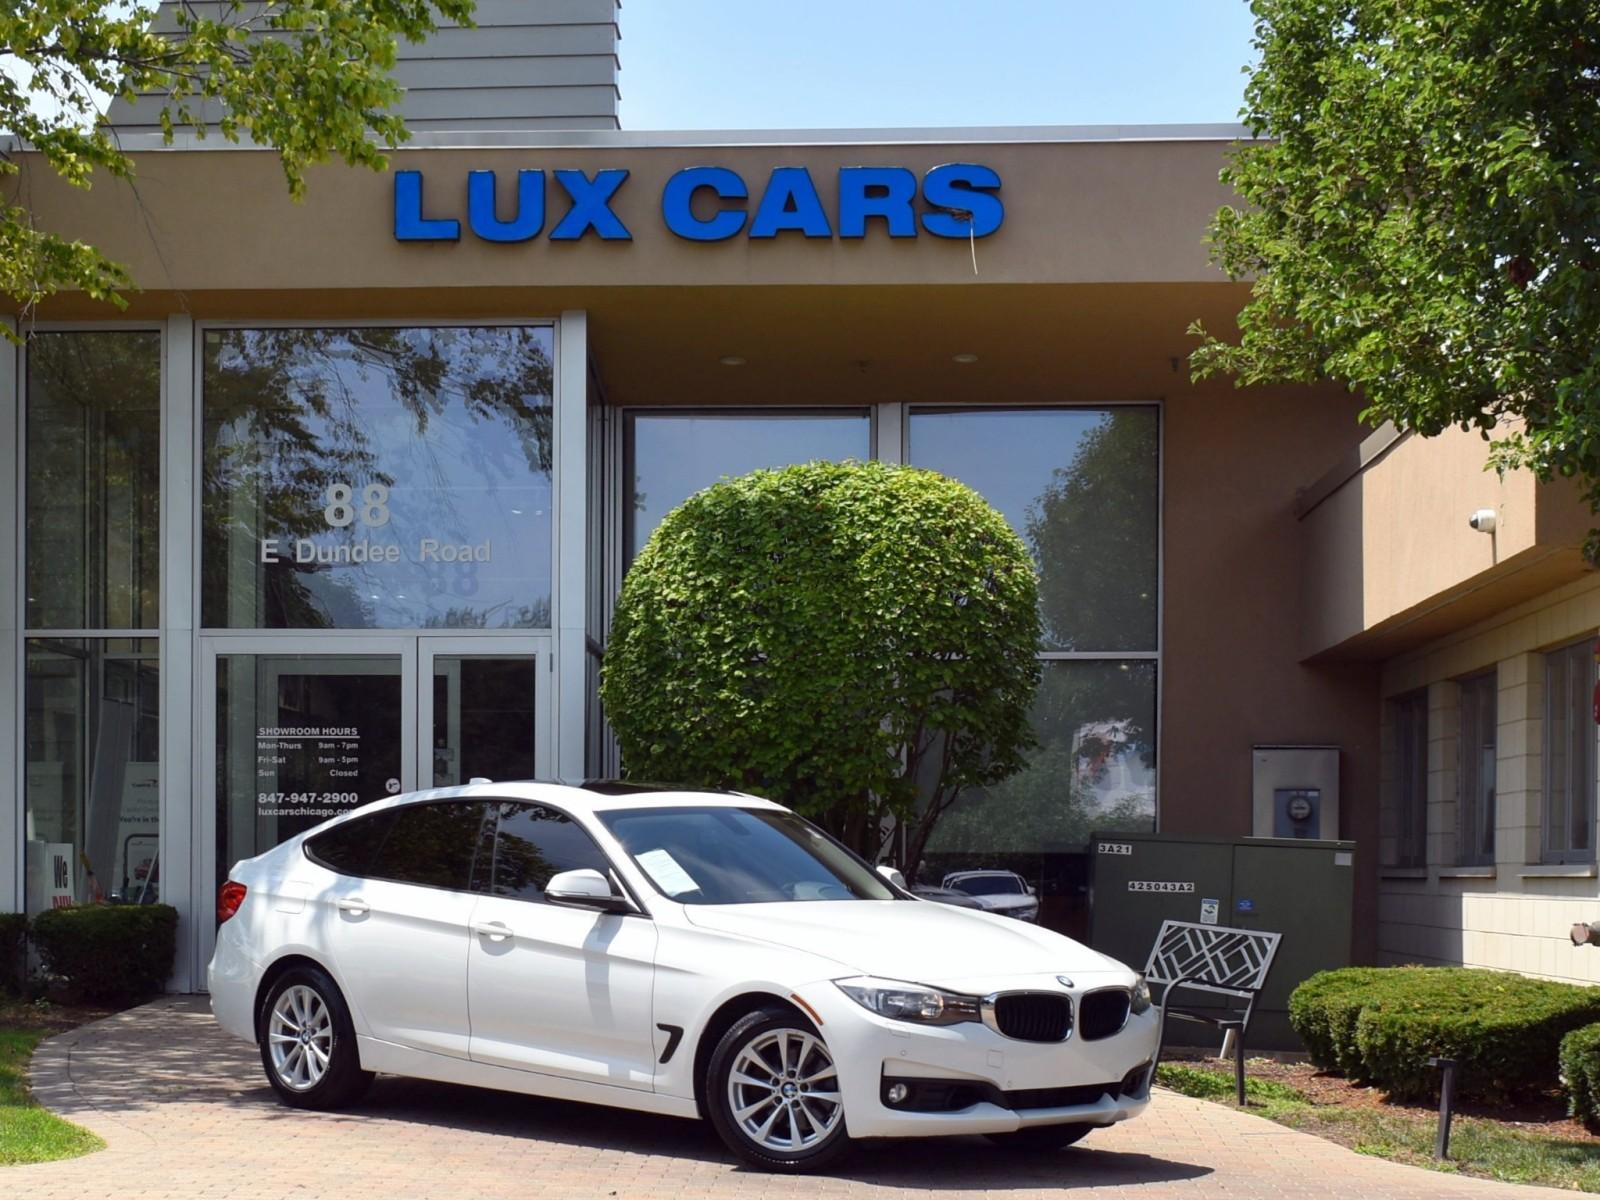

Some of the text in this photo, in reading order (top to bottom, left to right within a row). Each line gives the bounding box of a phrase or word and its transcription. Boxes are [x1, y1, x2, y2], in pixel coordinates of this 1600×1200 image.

[394, 162, 1005, 243] LUX CARS
[324, 483, 391, 528] 88
[261, 538, 492, 564] E Dundee Road
[259, 727, 358, 736] SHOWROOM HOURS
[257, 742, 302, 750] Mon-Thurs
[341, 741, 359, 750] 7pm
[257, 756, 286, 764] Fri-Sat
[341, 755, 359, 765] 5pm
[258, 769, 359, 777] Sun Closed
[258, 792, 359, 804] 847-947-2900
[1099, 844, 1131, 854] 3A21
[53, 855, 69, 889] We
[1129, 881, 1194, 892] 425043A2
